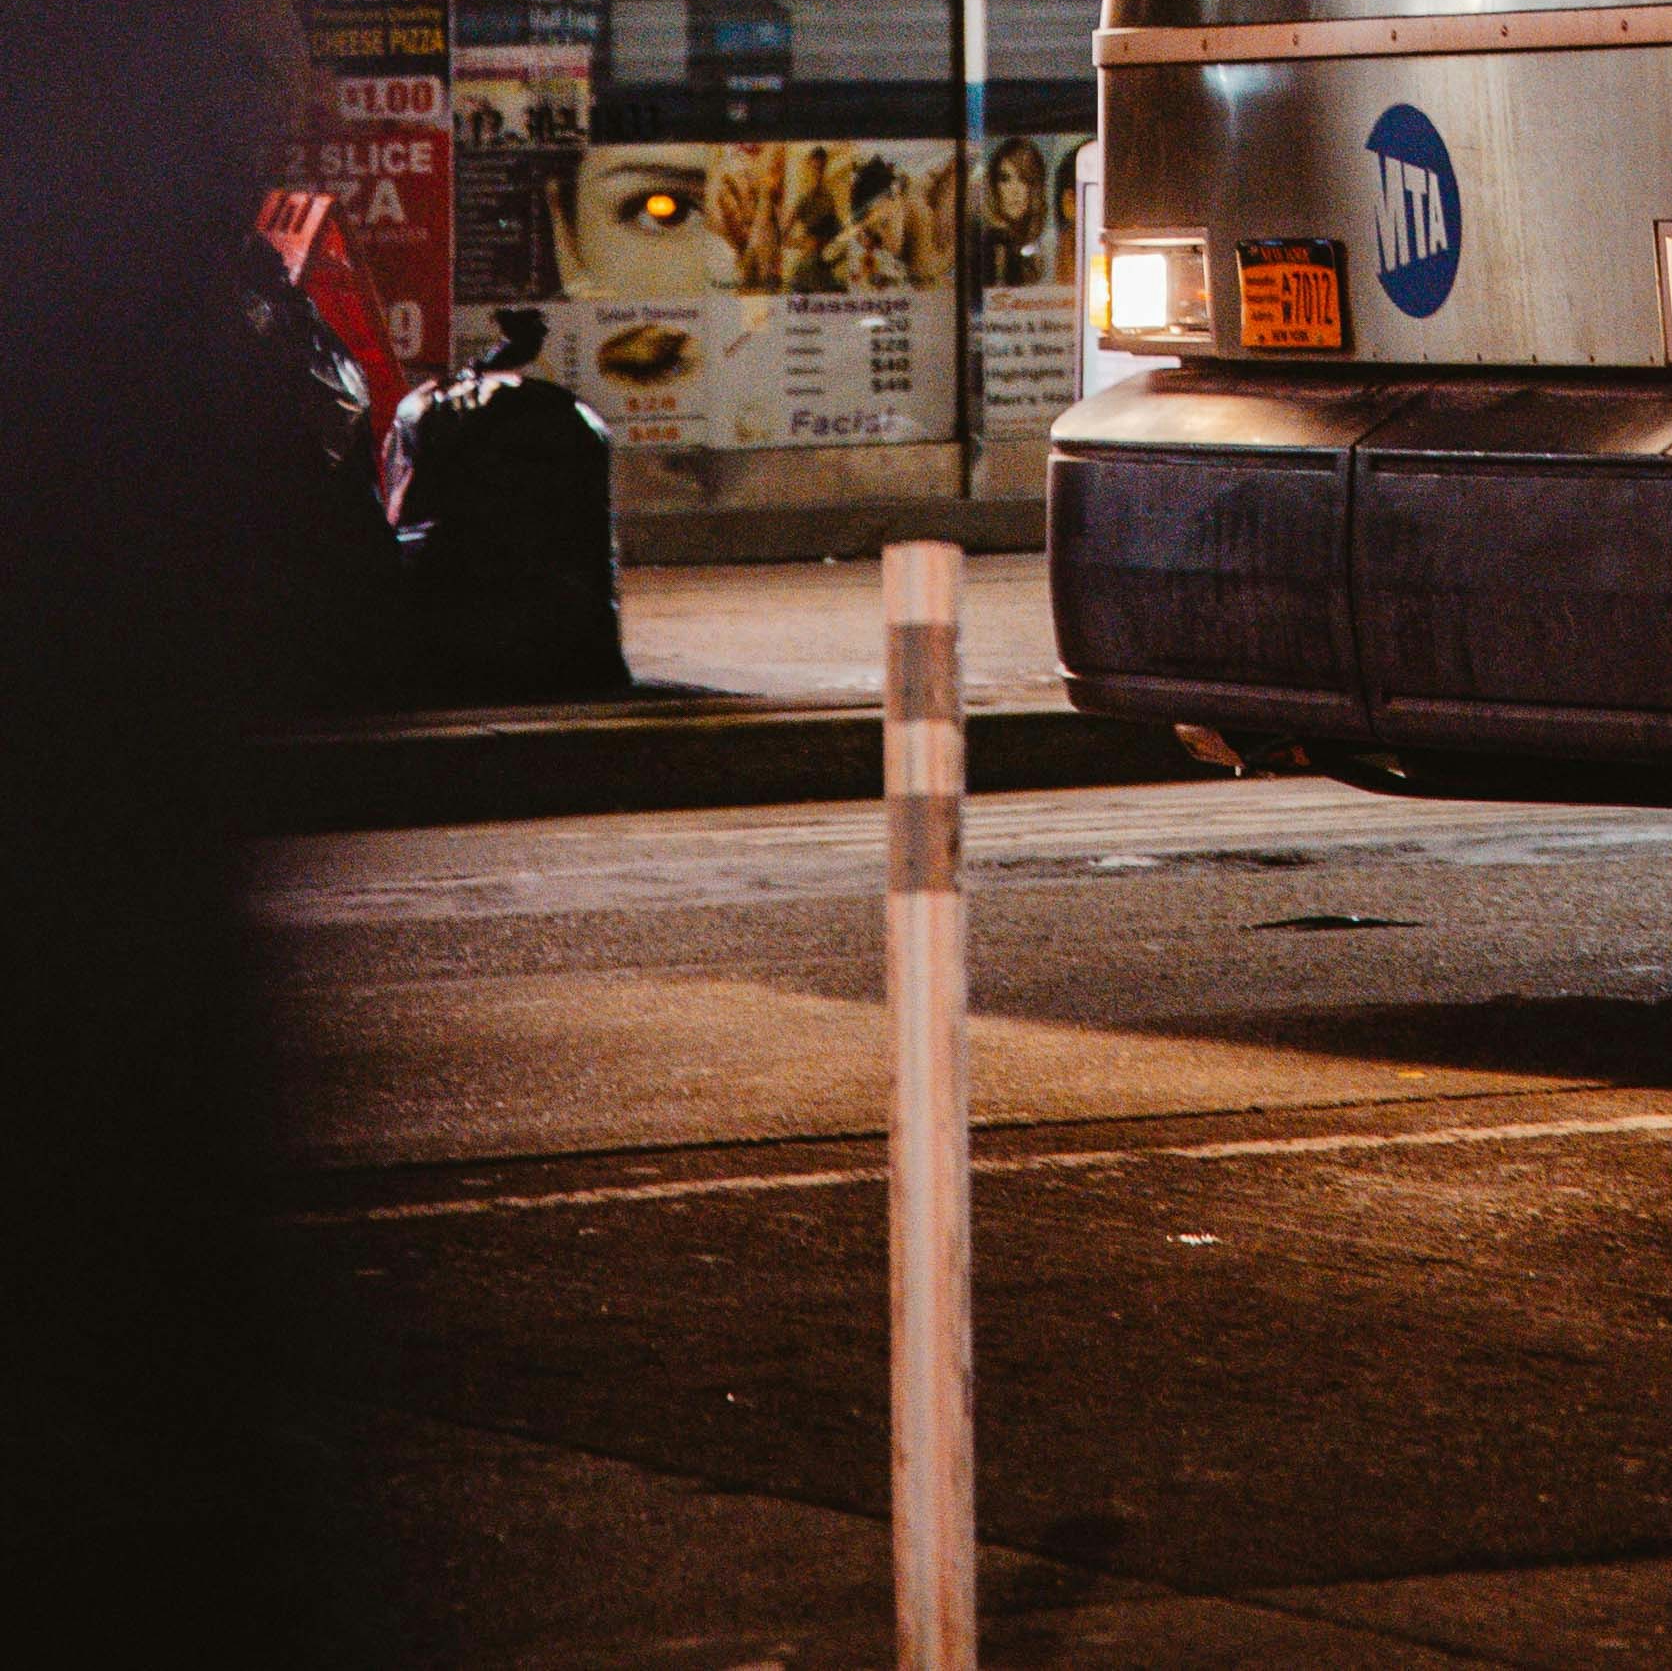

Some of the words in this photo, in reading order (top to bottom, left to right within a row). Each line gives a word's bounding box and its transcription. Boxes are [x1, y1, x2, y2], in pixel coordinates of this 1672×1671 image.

[319, 140, 434, 176] SLICE
[1372, 149, 1449, 275] MTA
[1292, 270, 1334, 325] 7012
